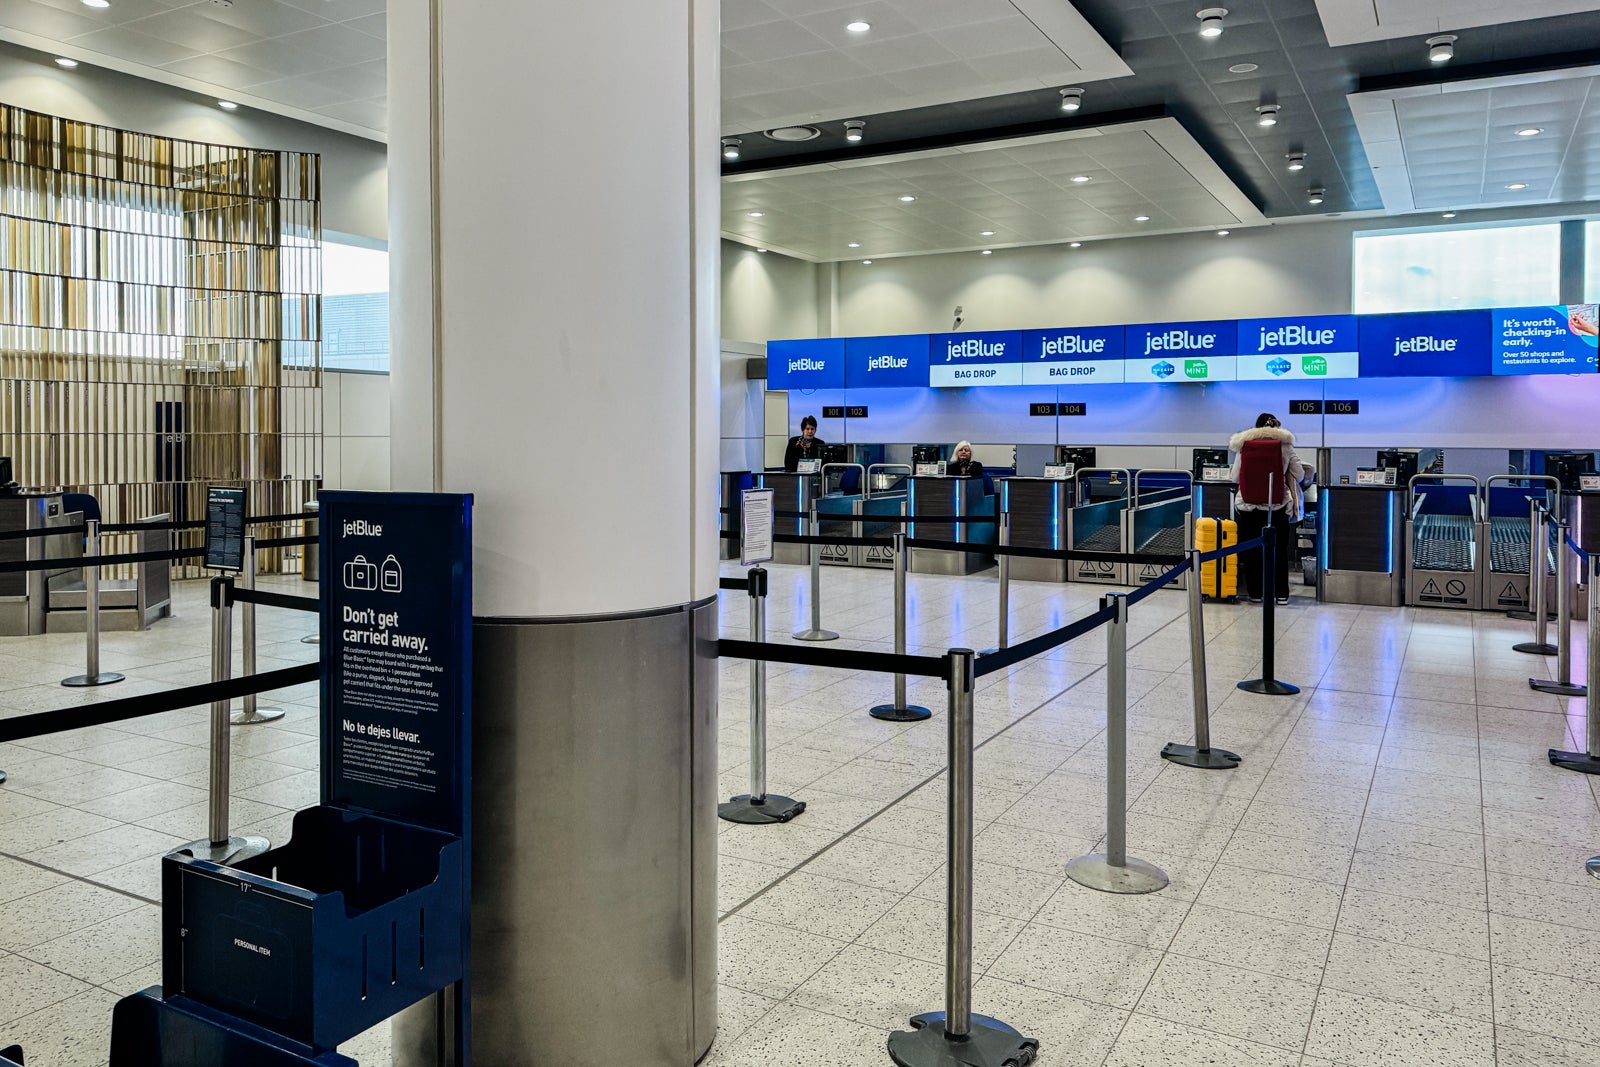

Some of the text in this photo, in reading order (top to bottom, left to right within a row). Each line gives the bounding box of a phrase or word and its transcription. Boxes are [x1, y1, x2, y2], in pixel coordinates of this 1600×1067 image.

[1503, 318, 1556, 328] It's worth
[1258, 326, 1336, 351] jetBlue
[1503, 327, 1566, 338] checking-in
[946, 339, 1006, 362] jetBlue
[1040, 335, 1106, 358] jetBlue
[1144, 330, 1216, 355] jetBlue
[1394, 336, 1458, 356] jetBlue
[1503, 337, 1533, 348] early.
[788, 358, 825, 374] jetBlue
[868, 356, 908, 372] jetBlue
[1049, 367, 1095, 376] BAG DROP
[1037, 406, 1050, 414] 103
[1298, 403, 1315, 411] 105
[1333, 402, 1352, 411] 106
[343, 519, 383, 538] jetBlue
[343, 606, 398, 630] Don't get
[343, 628, 428, 654] carried away.
[343, 719, 420, 744] No te dejes llevar.
[234, 938, 270, 956] PERSONAL ITEM
